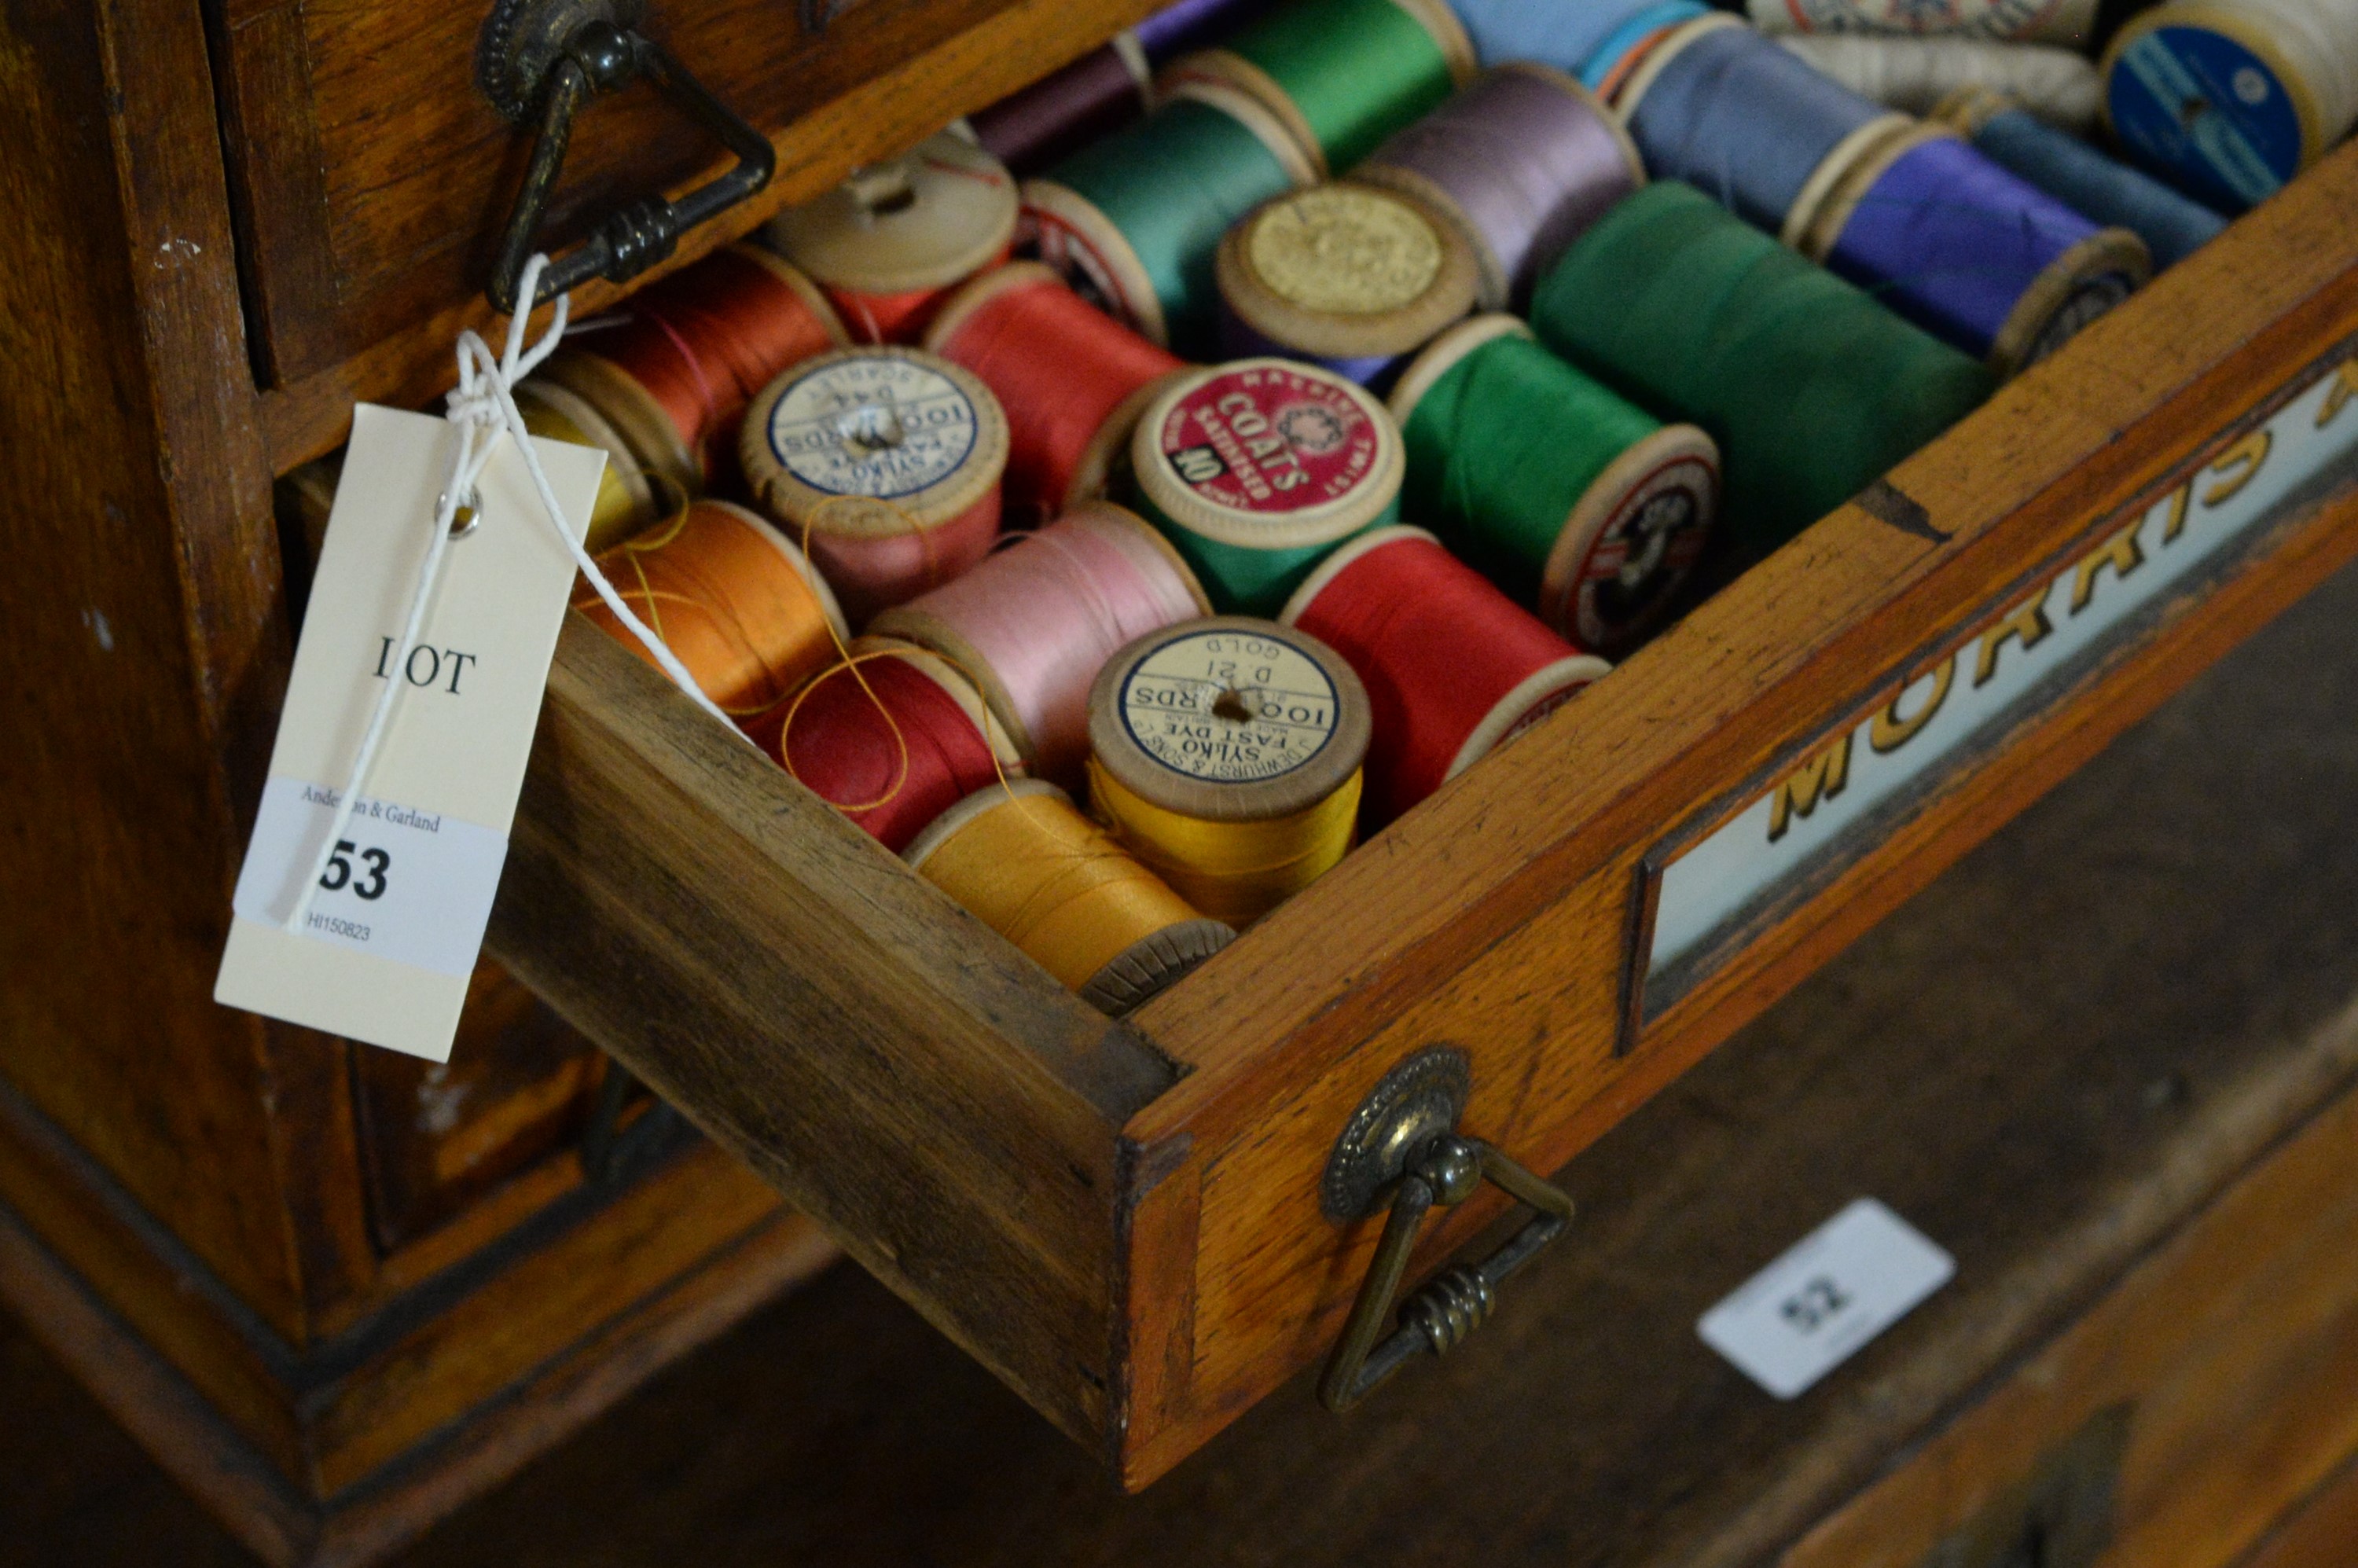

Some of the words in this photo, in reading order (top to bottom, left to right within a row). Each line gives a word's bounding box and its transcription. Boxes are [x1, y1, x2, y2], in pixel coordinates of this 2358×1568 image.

[1218, 393, 1311, 492] COATS
[1206, 639, 1280, 660] GOLD
[373, 636, 476, 695] LOT
[1207, 660, 1237, 679] 21
[1136, 687, 1198, 708] RDS
[1261, 701, 1324, 725] 100
[1167, 722, 1210, 739] DYE
[1224, 729, 1286, 749] FAST
[1183, 740, 1261, 762] SYLKO
[1210, 749, 1302, 779] DEWHURST
[370, 802, 383, 819] &
[386, 806, 441, 832] Garland
[319, 839, 391, 901] 53
